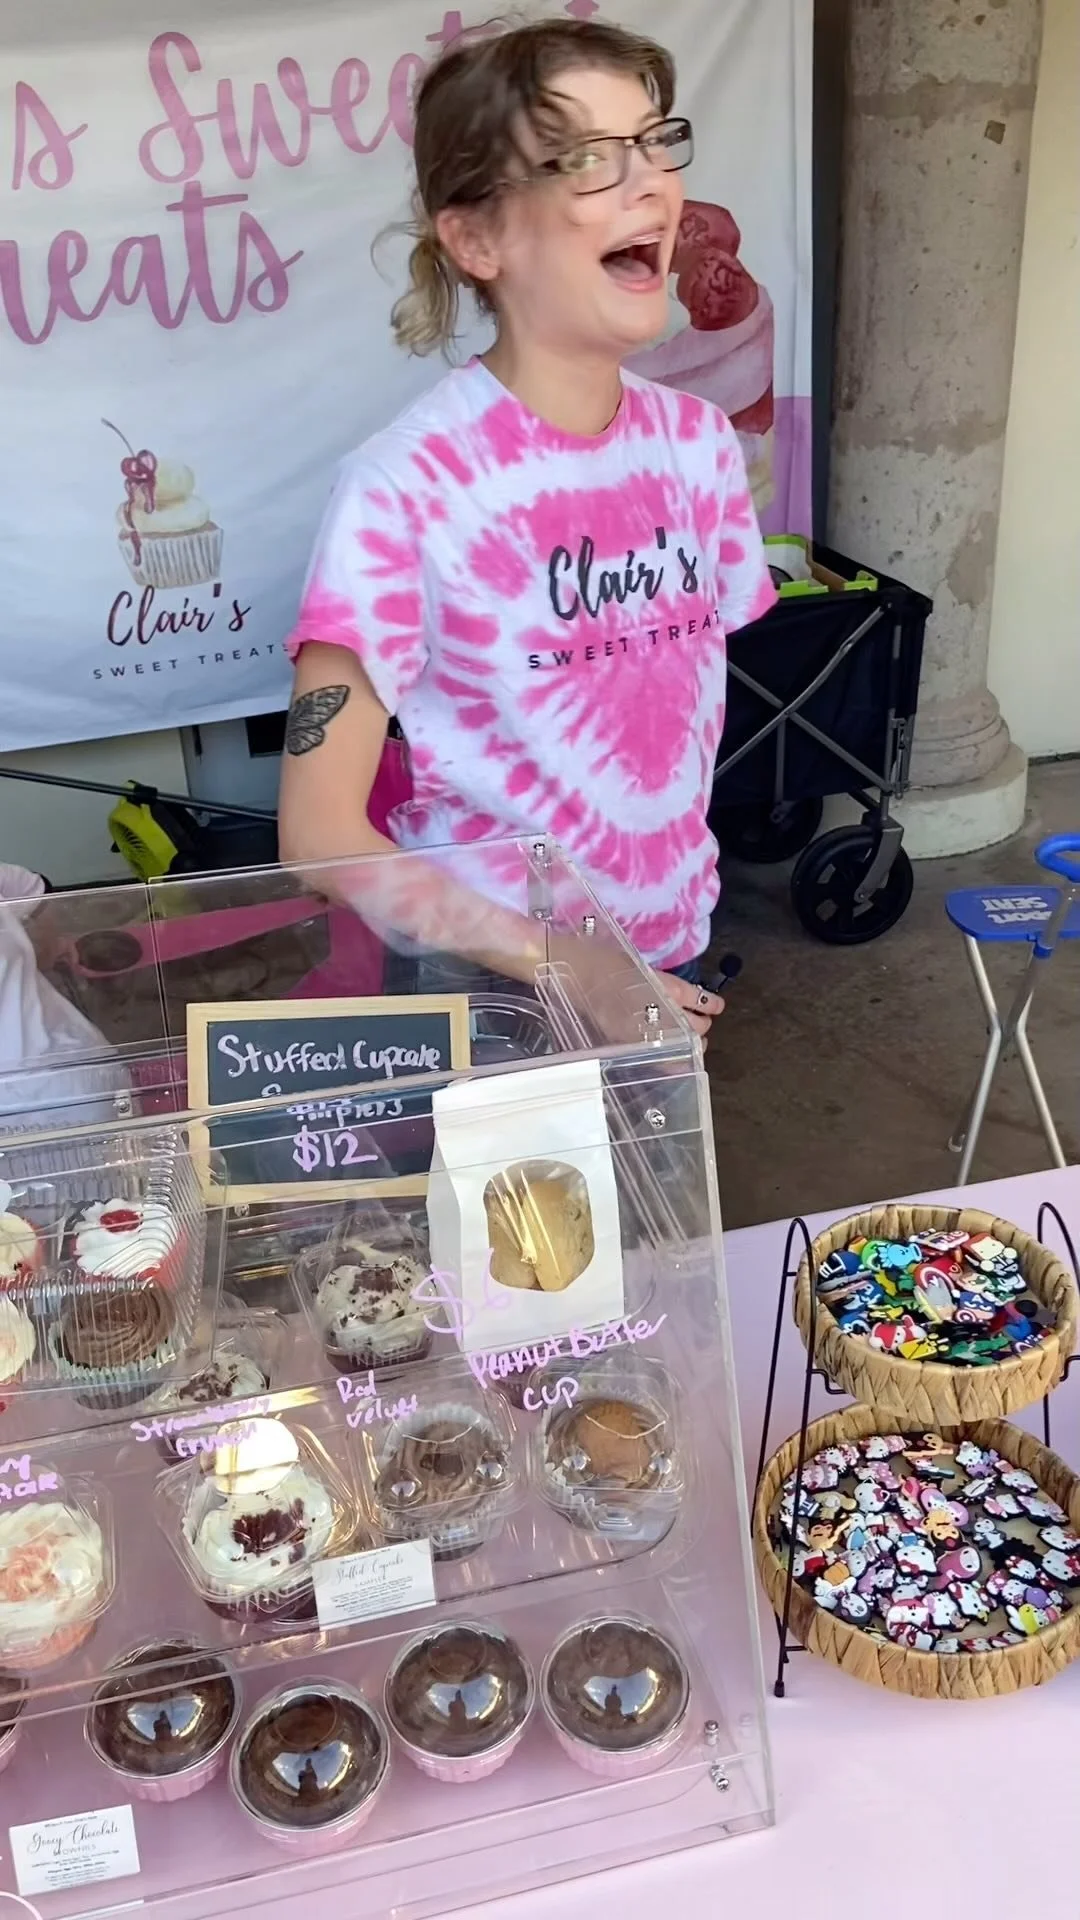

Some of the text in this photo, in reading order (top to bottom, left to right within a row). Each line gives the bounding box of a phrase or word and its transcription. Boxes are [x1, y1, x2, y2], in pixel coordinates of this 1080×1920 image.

[549, 526, 699, 621] Clair's
[106, 583, 252, 647] Clair's
[92, 658, 179, 680] SWEET
[528, 636, 629, 669] SWEET
[217, 1034, 441, 1080] Stuffed Cupcake
[293, 1124, 379, 1173] $12
[412, 1247, 512, 1353] $6
[71, 1821, 120, 1844] Chocolate
